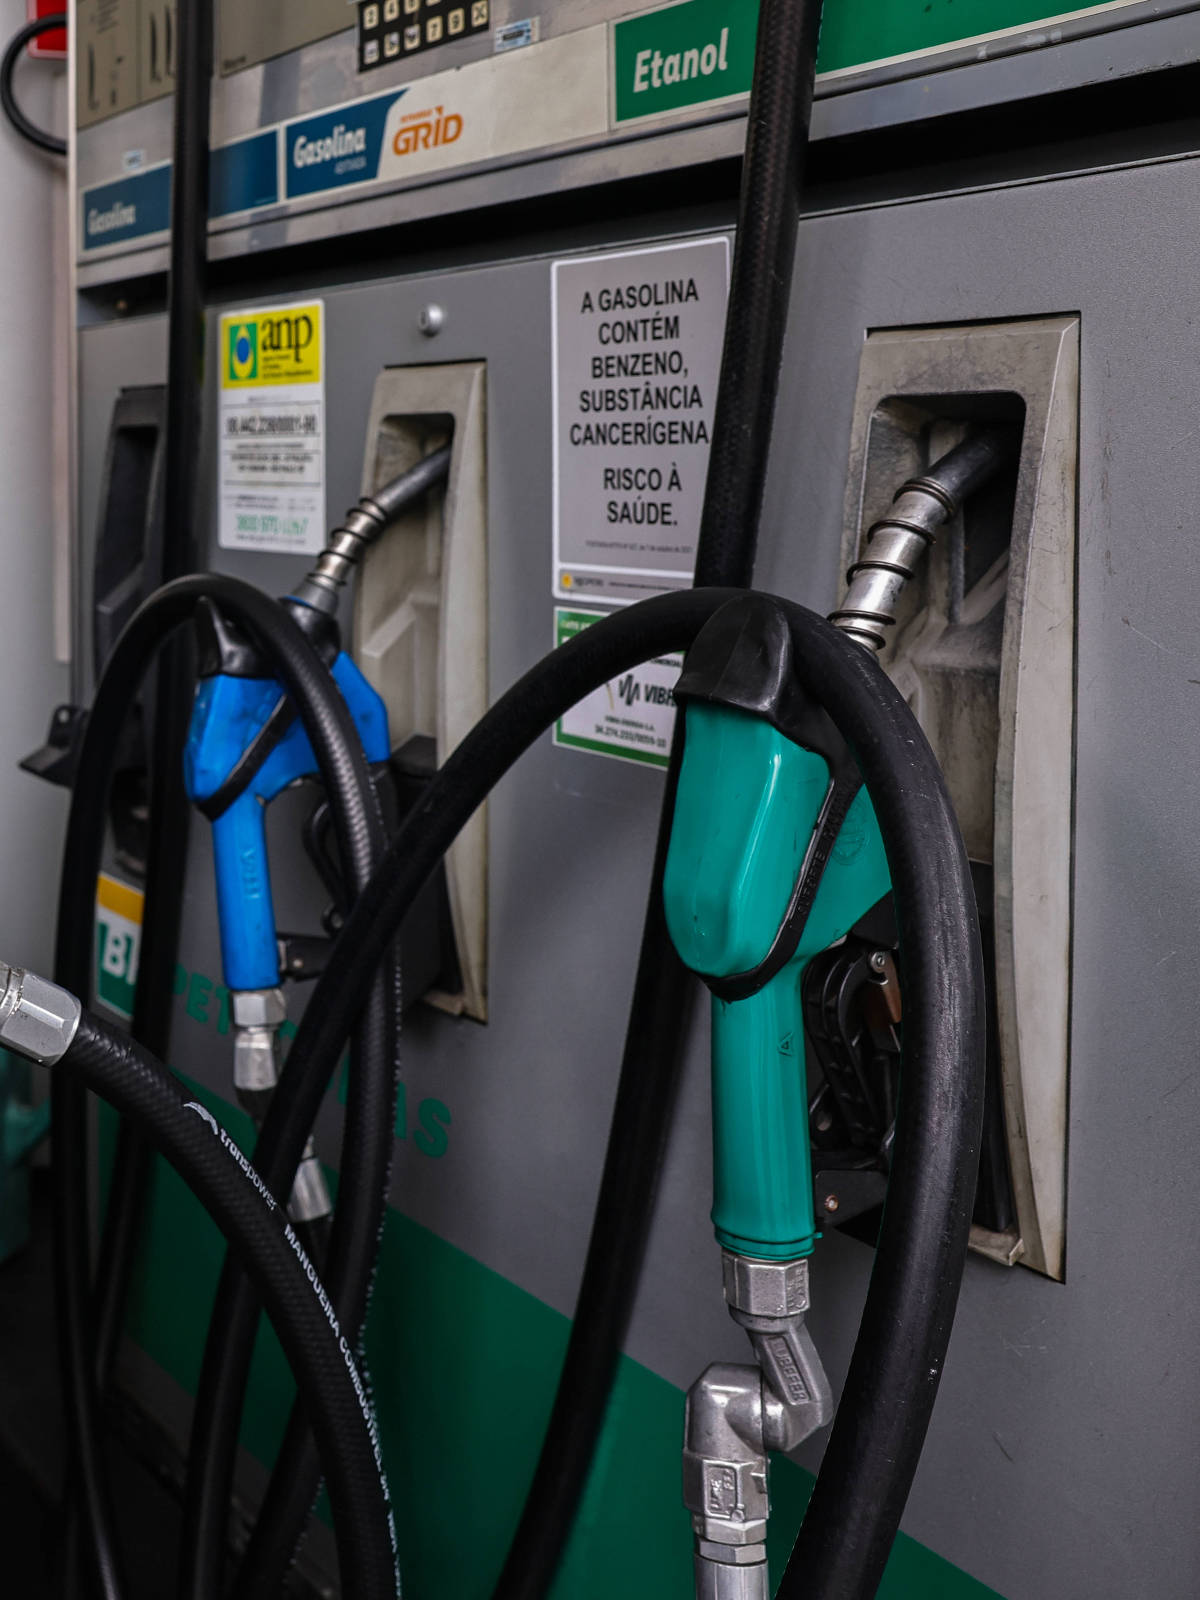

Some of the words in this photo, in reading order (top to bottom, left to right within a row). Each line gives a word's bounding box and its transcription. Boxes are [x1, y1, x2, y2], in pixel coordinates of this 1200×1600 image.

[632, 26, 730, 94] Etanol
[292, 123, 368, 168] Gasolina
[580, 291, 594, 314] A
[598, 277, 699, 312] GASOLINA
[260, 314, 314, 363] anp
[598, 311, 681, 345] CONTÉM
[591, 350, 689, 379] BENZENO,
[579, 381, 703, 413] SUBSTÂNCIA
[569, 415, 710, 446] CANCERÍGENA
[603, 467, 663, 491] RISCO
[667, 461, 682, 492] À
[606, 495, 678, 526] SAÚDE.
[644, 683, 678, 708] VIBR
[220, 1127, 278, 1211] transpower
